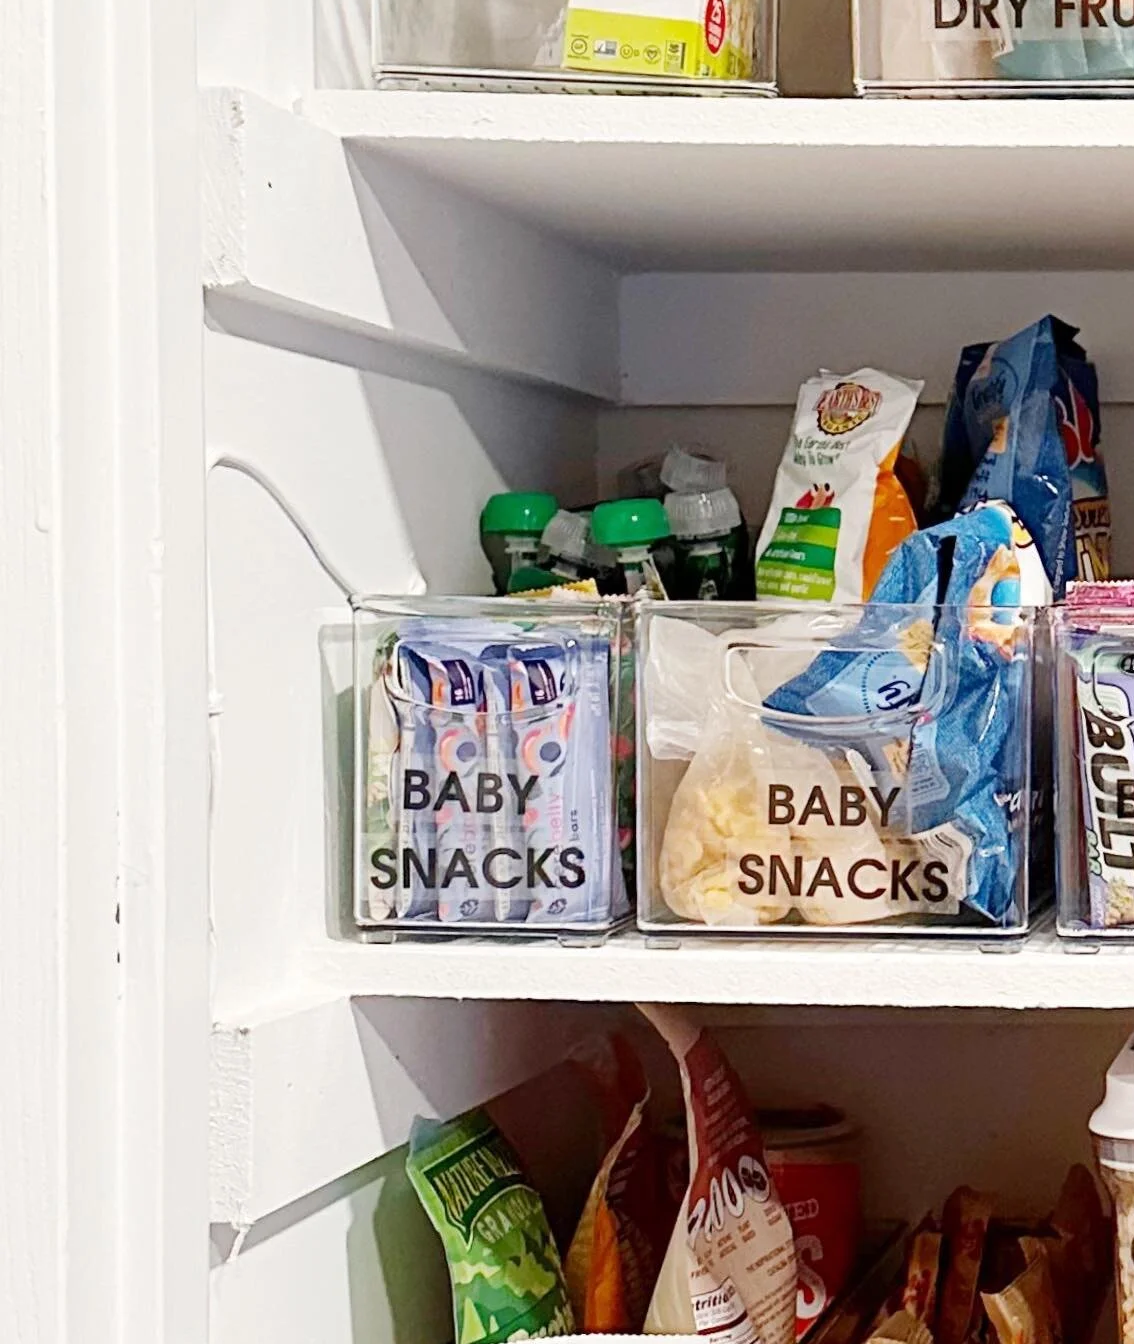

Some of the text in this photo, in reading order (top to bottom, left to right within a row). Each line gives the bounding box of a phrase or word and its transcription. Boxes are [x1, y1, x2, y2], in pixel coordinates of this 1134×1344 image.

[403, 769, 539, 815] BABY
[768, 783, 902, 828] BABY
[370, 847, 587, 891] SNACKS
[737, 853, 950, 903] SNACKS
